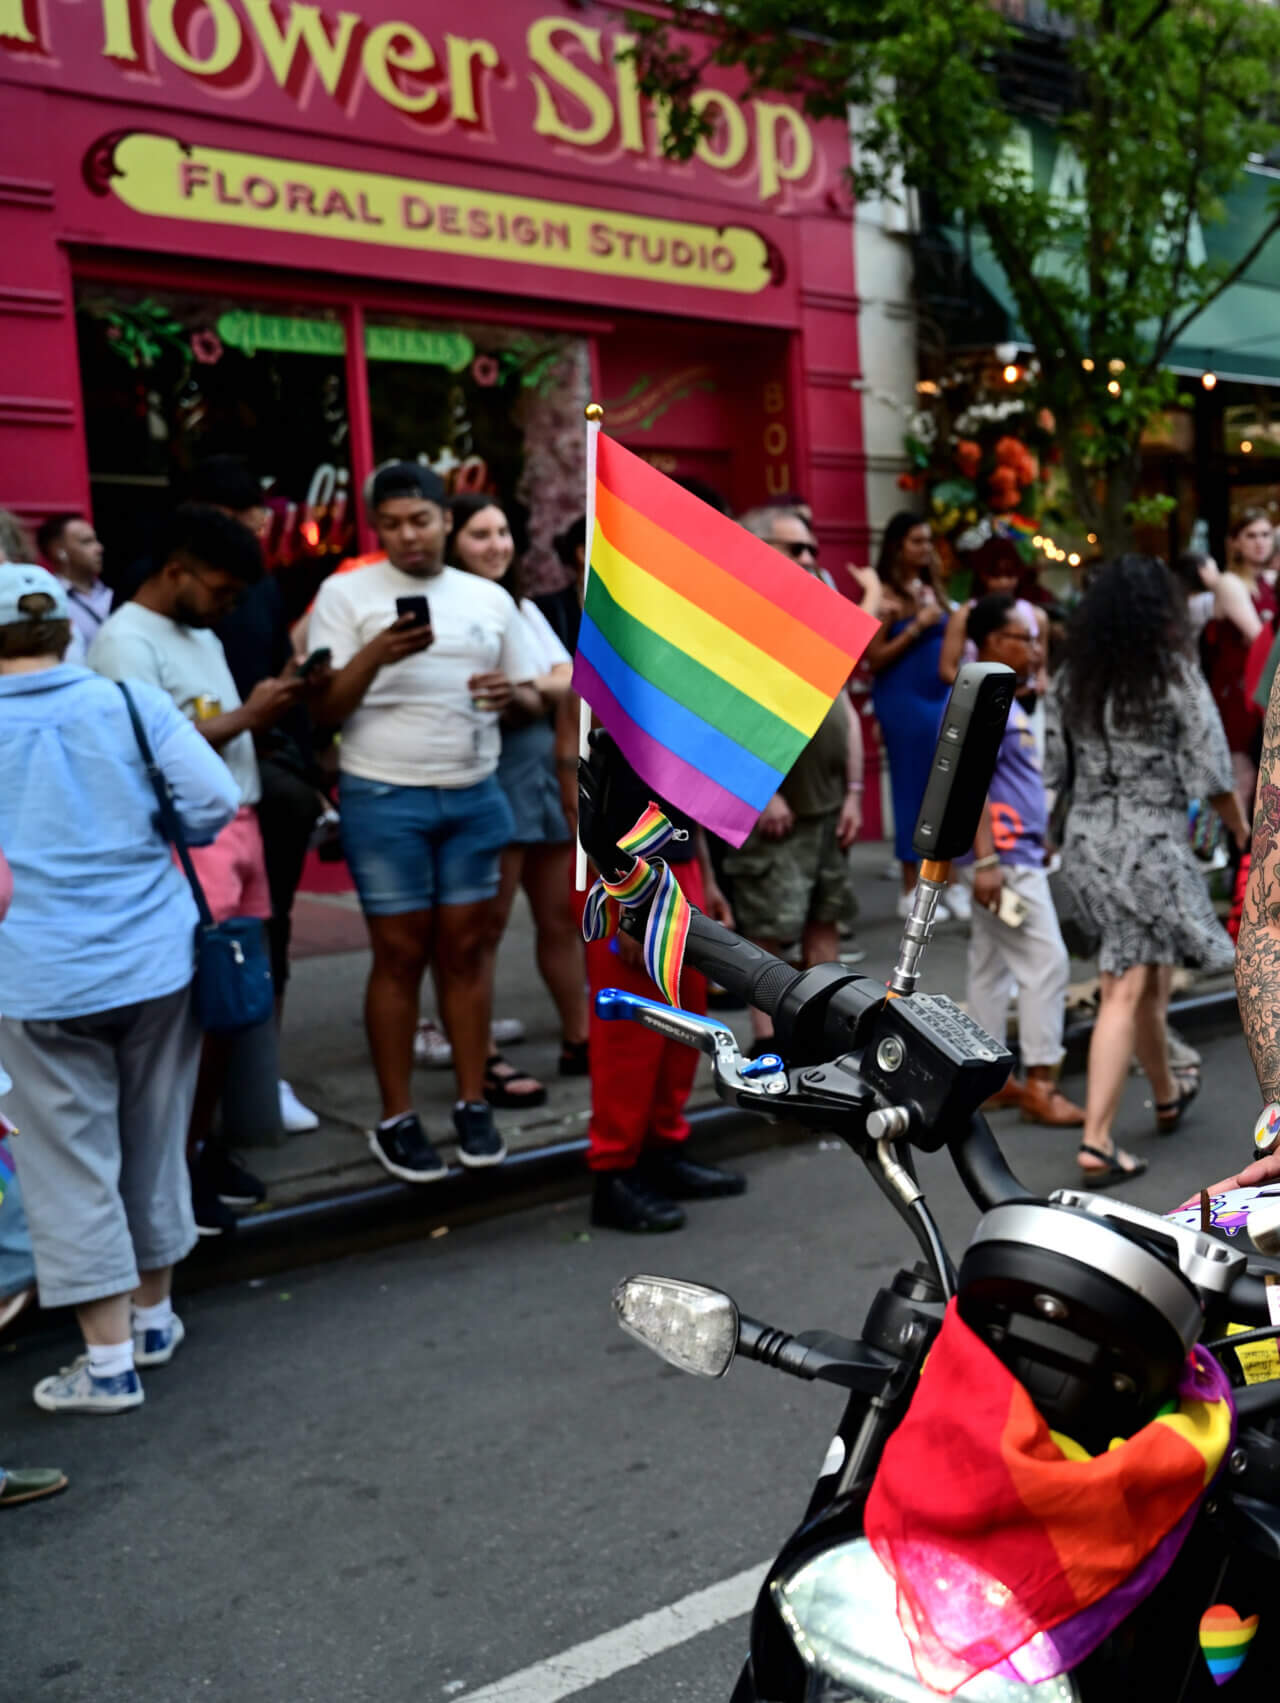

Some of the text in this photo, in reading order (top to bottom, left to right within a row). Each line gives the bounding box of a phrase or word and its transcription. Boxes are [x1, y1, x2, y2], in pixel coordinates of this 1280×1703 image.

[0, 0, 813, 199] ower Shop
[179, 160, 737, 275] FLORAL DESIGN STUDIO
